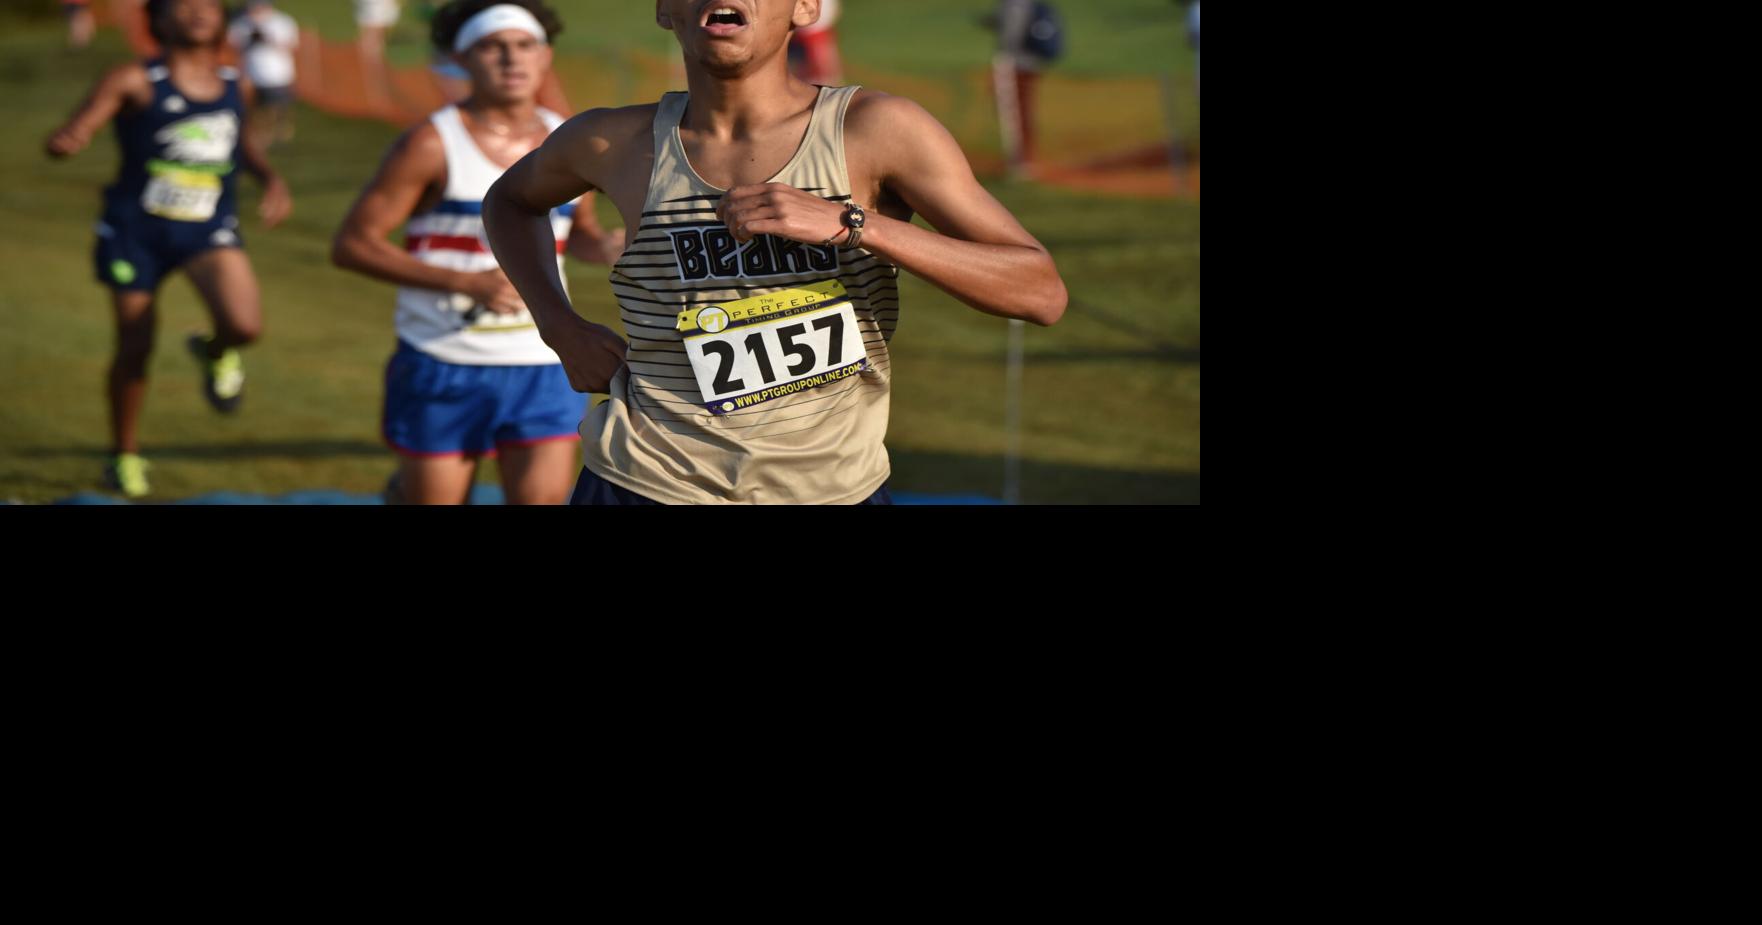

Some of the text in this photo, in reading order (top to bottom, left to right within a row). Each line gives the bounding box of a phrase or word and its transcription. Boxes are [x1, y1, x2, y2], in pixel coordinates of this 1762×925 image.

[732, 291, 829, 319] PERFECT
[700, 312, 725, 331] PT
[701, 313, 844, 395] 2157
